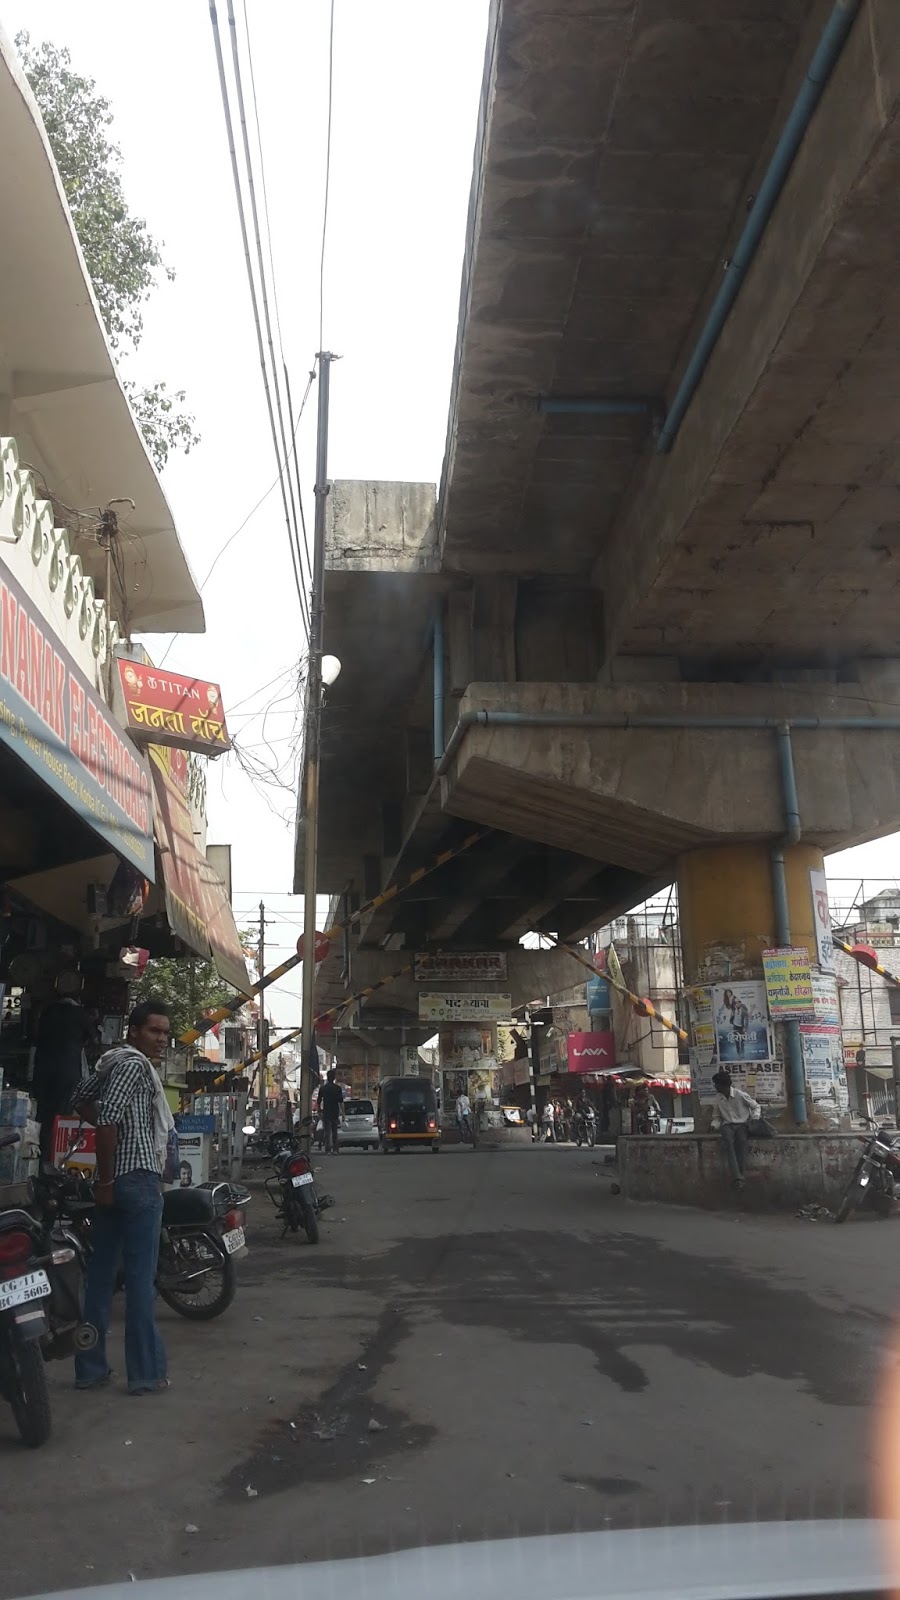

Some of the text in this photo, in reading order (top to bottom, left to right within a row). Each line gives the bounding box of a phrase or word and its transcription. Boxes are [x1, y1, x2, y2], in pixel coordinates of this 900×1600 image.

[158, 679, 200, 699] TITAN
[0, 582, 149, 837] NANAK ELECTRICALS
[128, 700, 227, 743] जनता वॉच
[43, 741, 63, 779] House
[573, 1048, 608, 1056] LAVA
[24, 1283, 49, 1300] 5605
